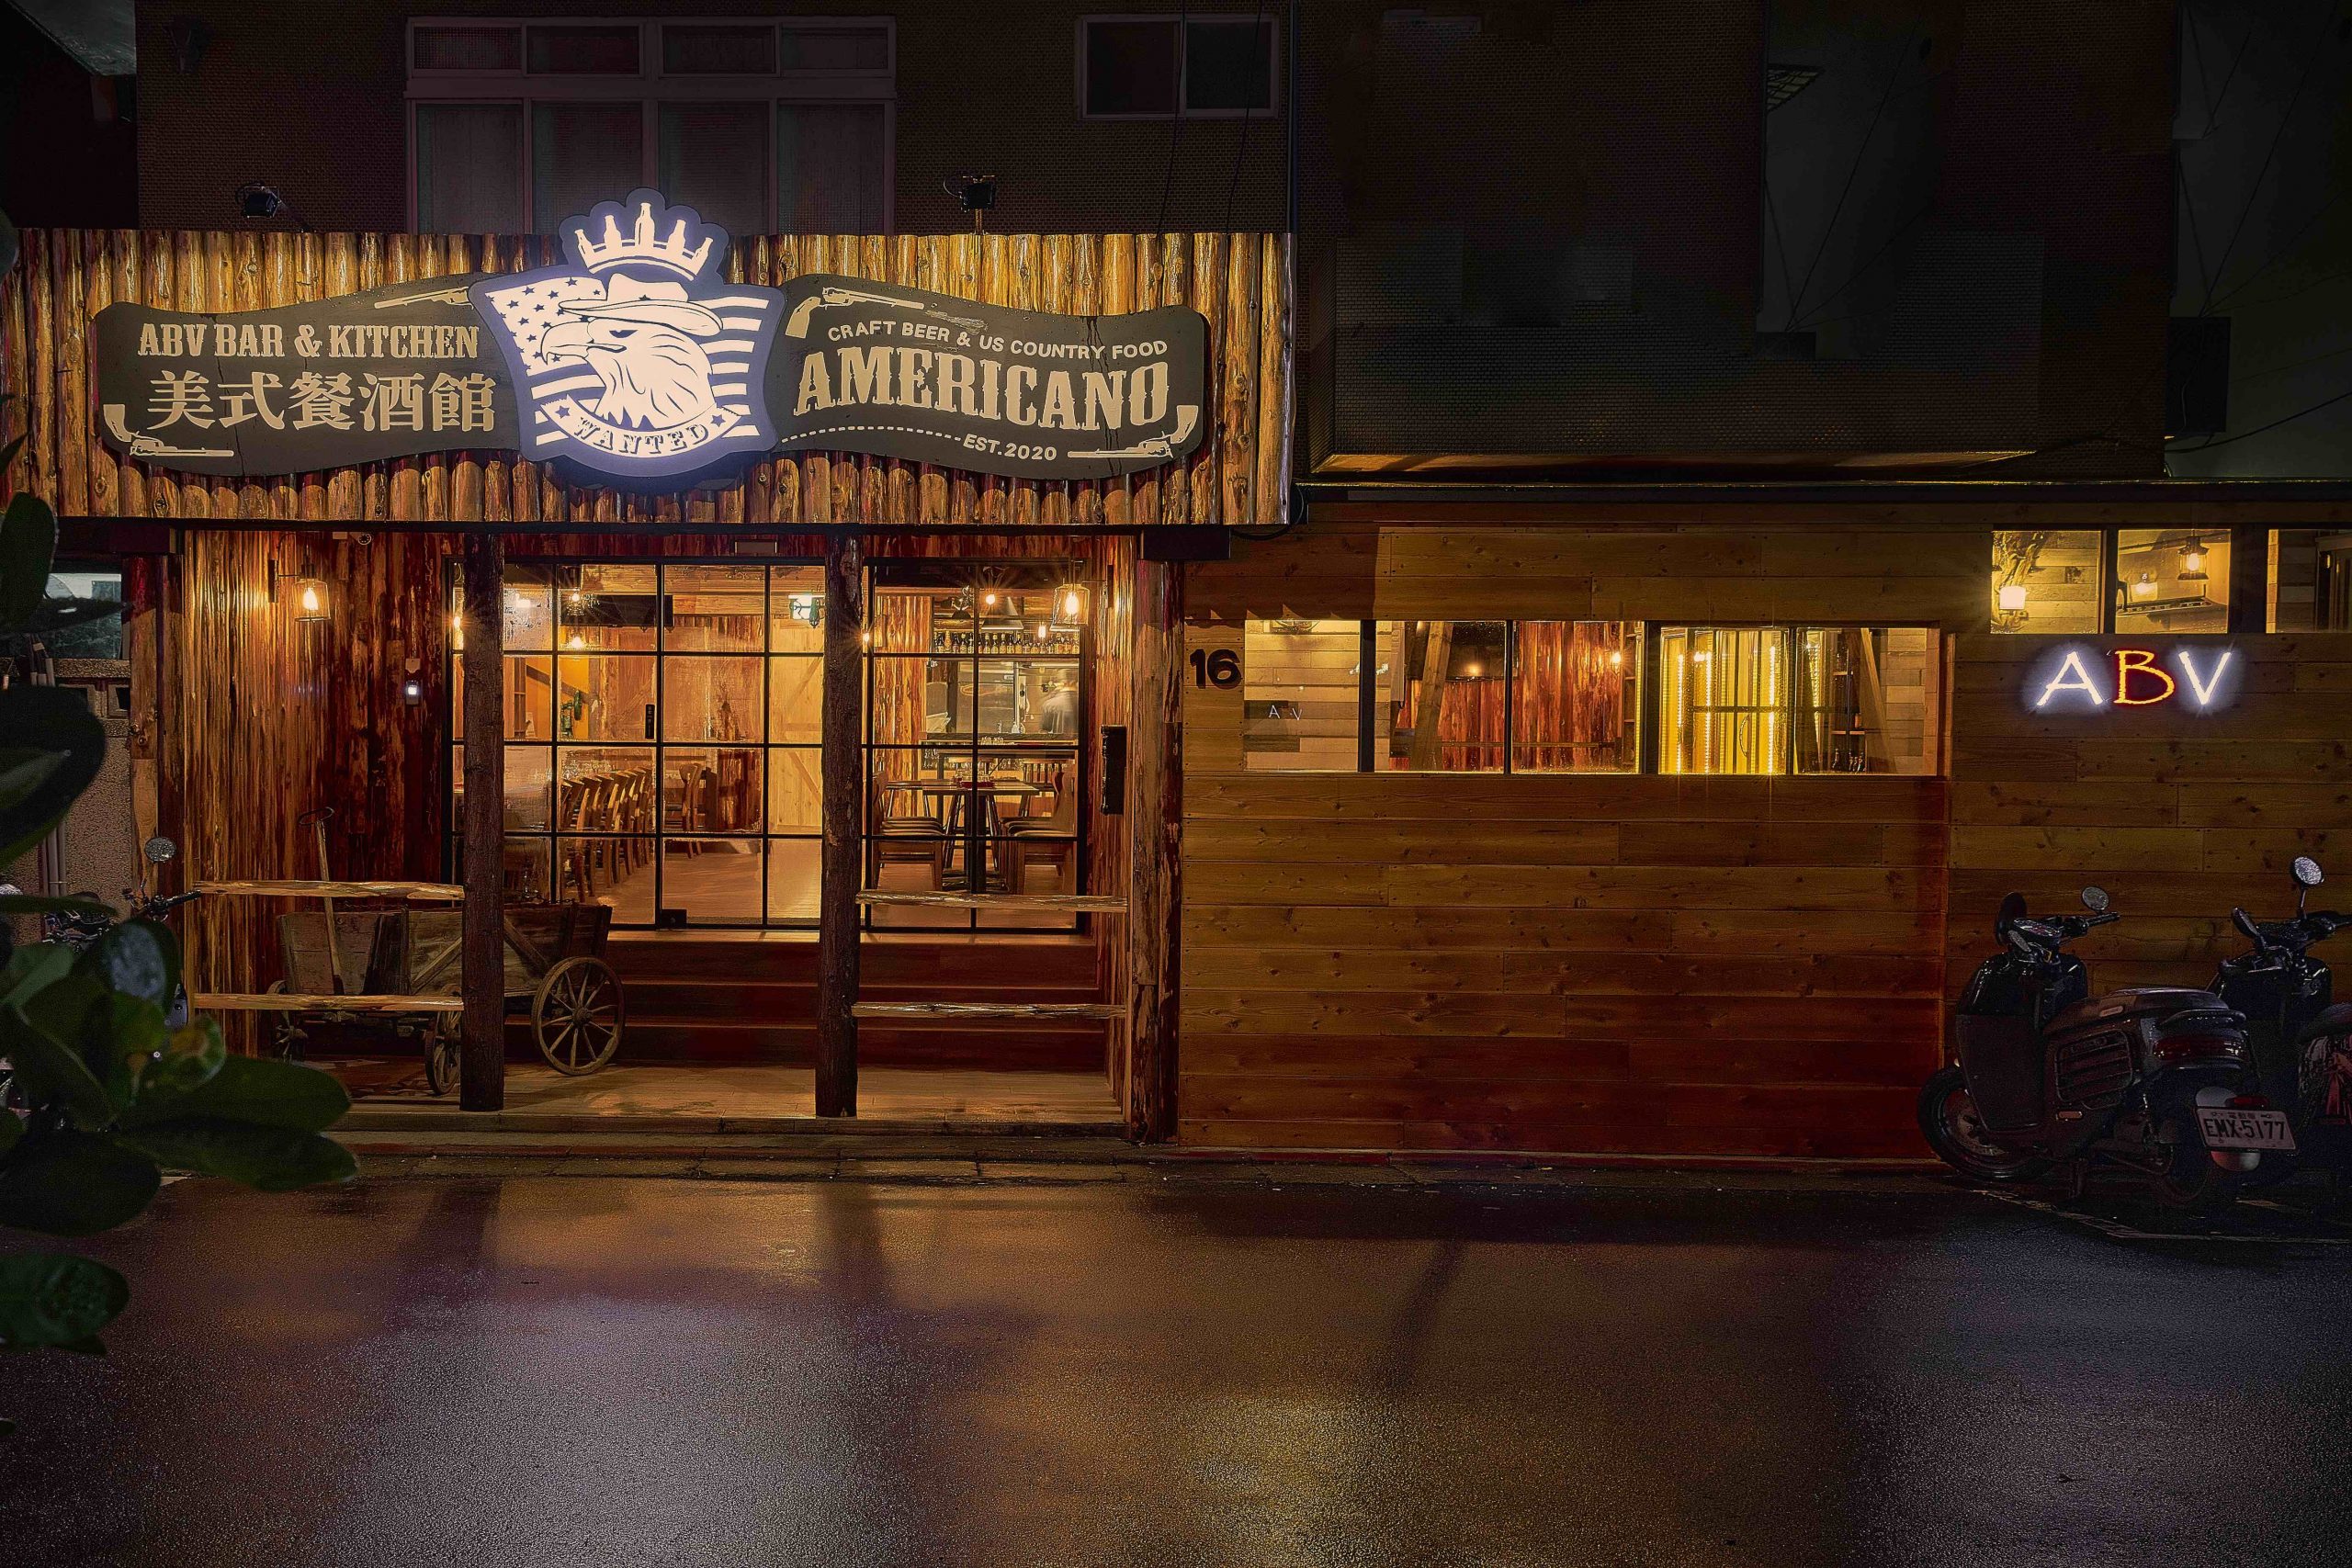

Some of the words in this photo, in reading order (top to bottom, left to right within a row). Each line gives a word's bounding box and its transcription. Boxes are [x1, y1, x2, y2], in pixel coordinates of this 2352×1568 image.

[137, 323, 208, 356] ABV
[213, 323, 285, 357] BAR
[293, 324, 322, 358] &
[328, 325, 480, 358] KITCHEN
[827, 321, 897, 342] CRAFT
[901, 322, 950, 343] BEER
[956, 332, 971, 347] &
[978, 334, 1004, 353] US
[1010, 340, 1105, 360] COUNTRY
[1112, 340, 1168, 360] FOOD
[146, 370, 497, 433] 美式餐酒館
[793, 345, 1170, 431] AMERICANO
[573, 416, 709, 455] WANTED
[1189, 649, 1241, 690] 16
[2036, 649, 2233, 706] ABV
